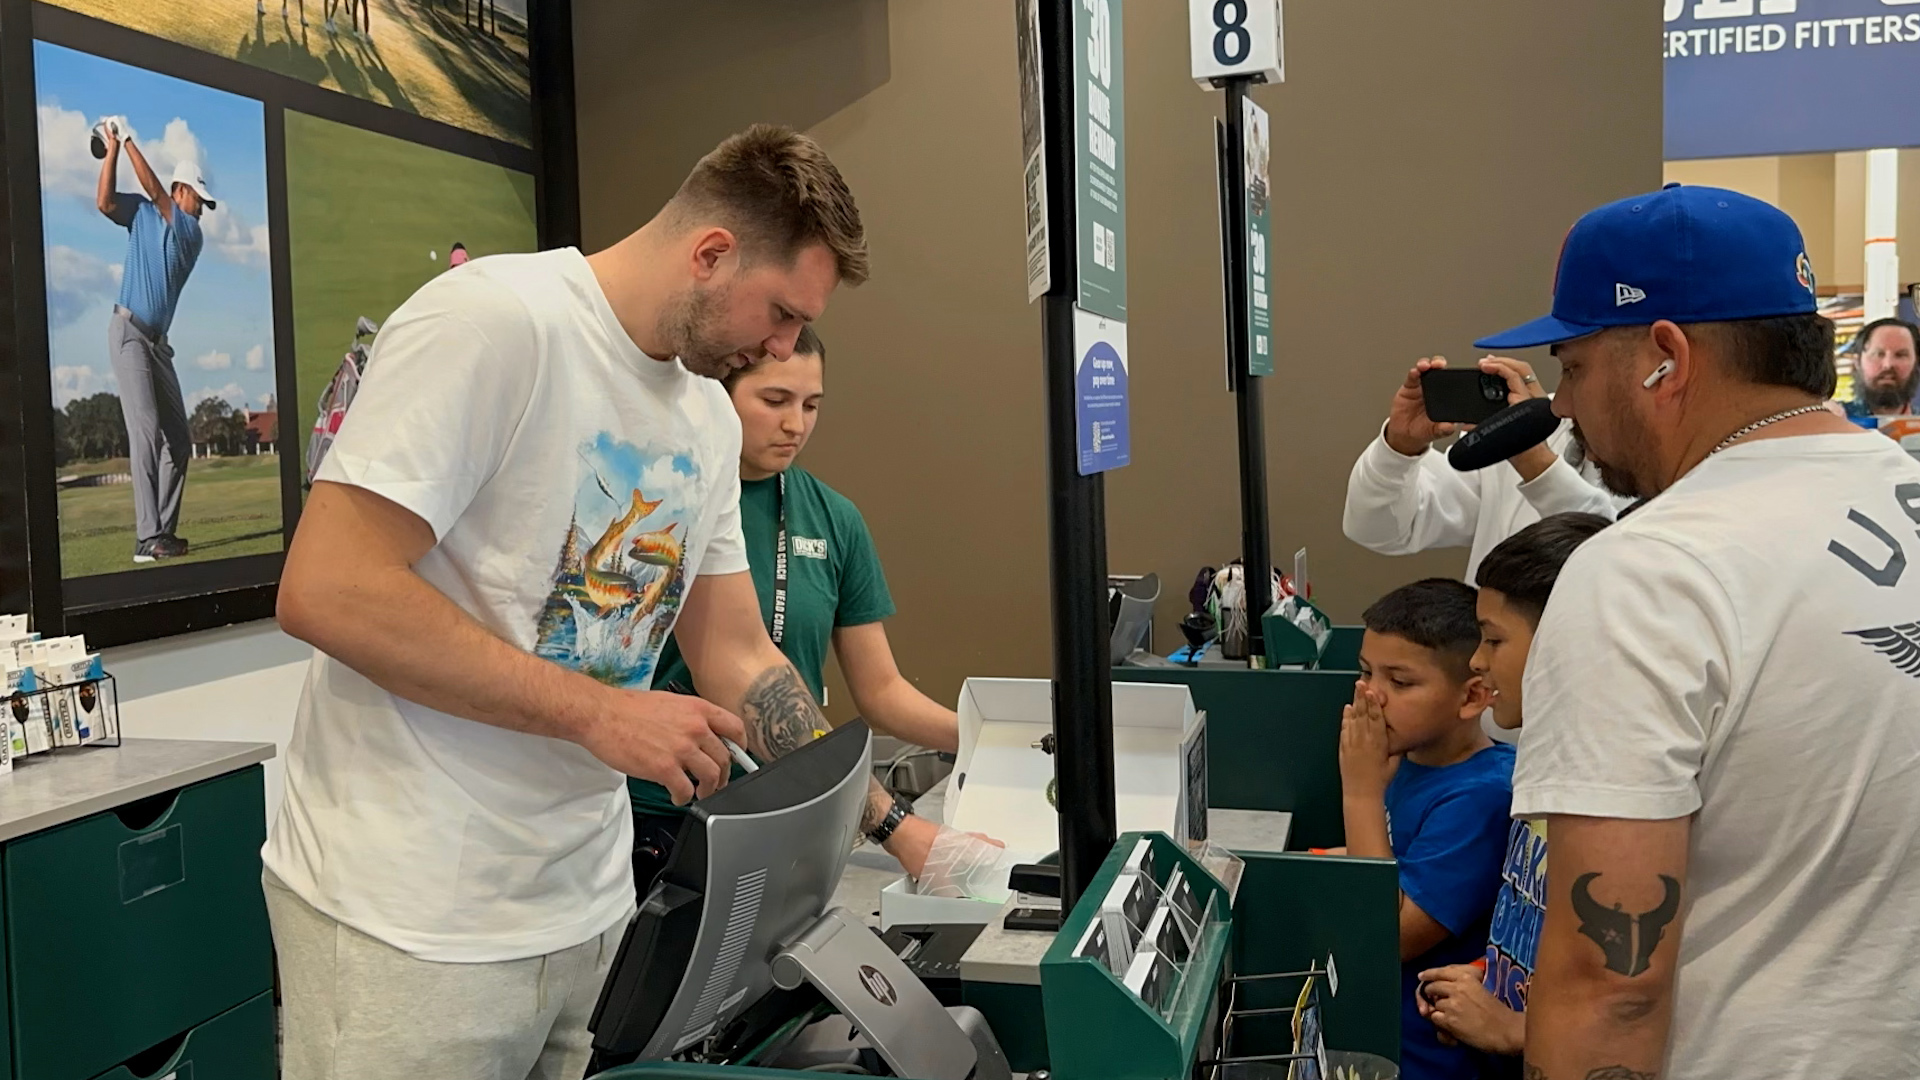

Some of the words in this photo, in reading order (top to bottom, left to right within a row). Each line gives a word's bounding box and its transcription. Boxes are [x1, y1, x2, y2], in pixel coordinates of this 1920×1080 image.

[1212, 0, 1251, 66] 8
[1795, 14, 1920, 49] FITTERS
[777, 529, 786, 553] HEAD
[776, 553, 787, 580] COACH
[774, 589, 786, 613] HEAD
[772, 612, 785, 643] COACH
[858, 967, 895, 1007] hp
